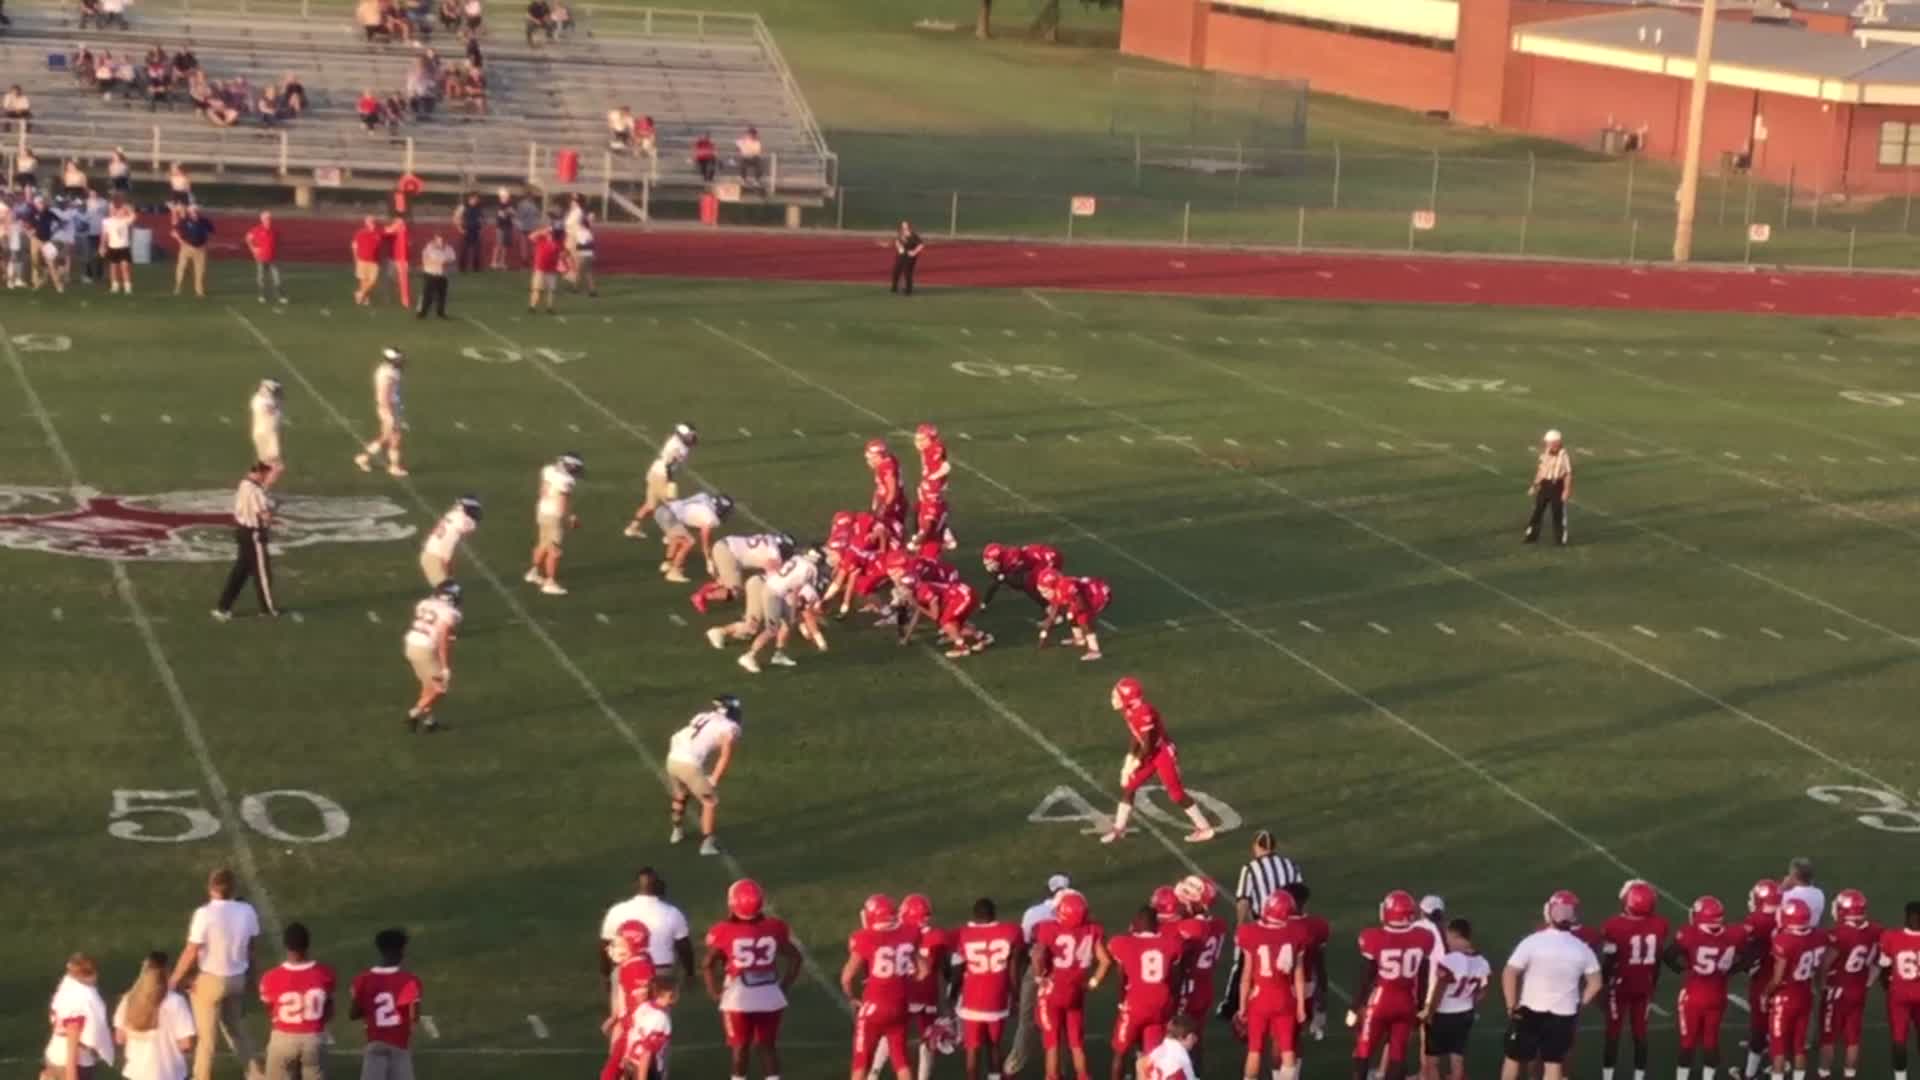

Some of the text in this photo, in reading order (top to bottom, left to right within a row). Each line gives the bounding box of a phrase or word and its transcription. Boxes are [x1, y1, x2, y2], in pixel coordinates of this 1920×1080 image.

[108, 788, 350, 843] 50
[1027, 785, 1243, 835] 40
[1806, 784, 1920, 833] 3
[732, 933, 777, 968] 53
[872, 943, 915, 978] 66
[964, 939, 1010, 974] 52
[1053, 934, 1094, 969] 34
[1141, 950, 1163, 984] 8
[1257, 943, 1294, 977] 14
[1378, 947, 1423, 980] 50
[1629, 933, 1657, 966] 11
[1693, 945, 1736, 975] 54
[1896, 949, 1920, 980] 6
[278, 988, 326, 1023] 20
[375, 993, 400, 1027] 2
